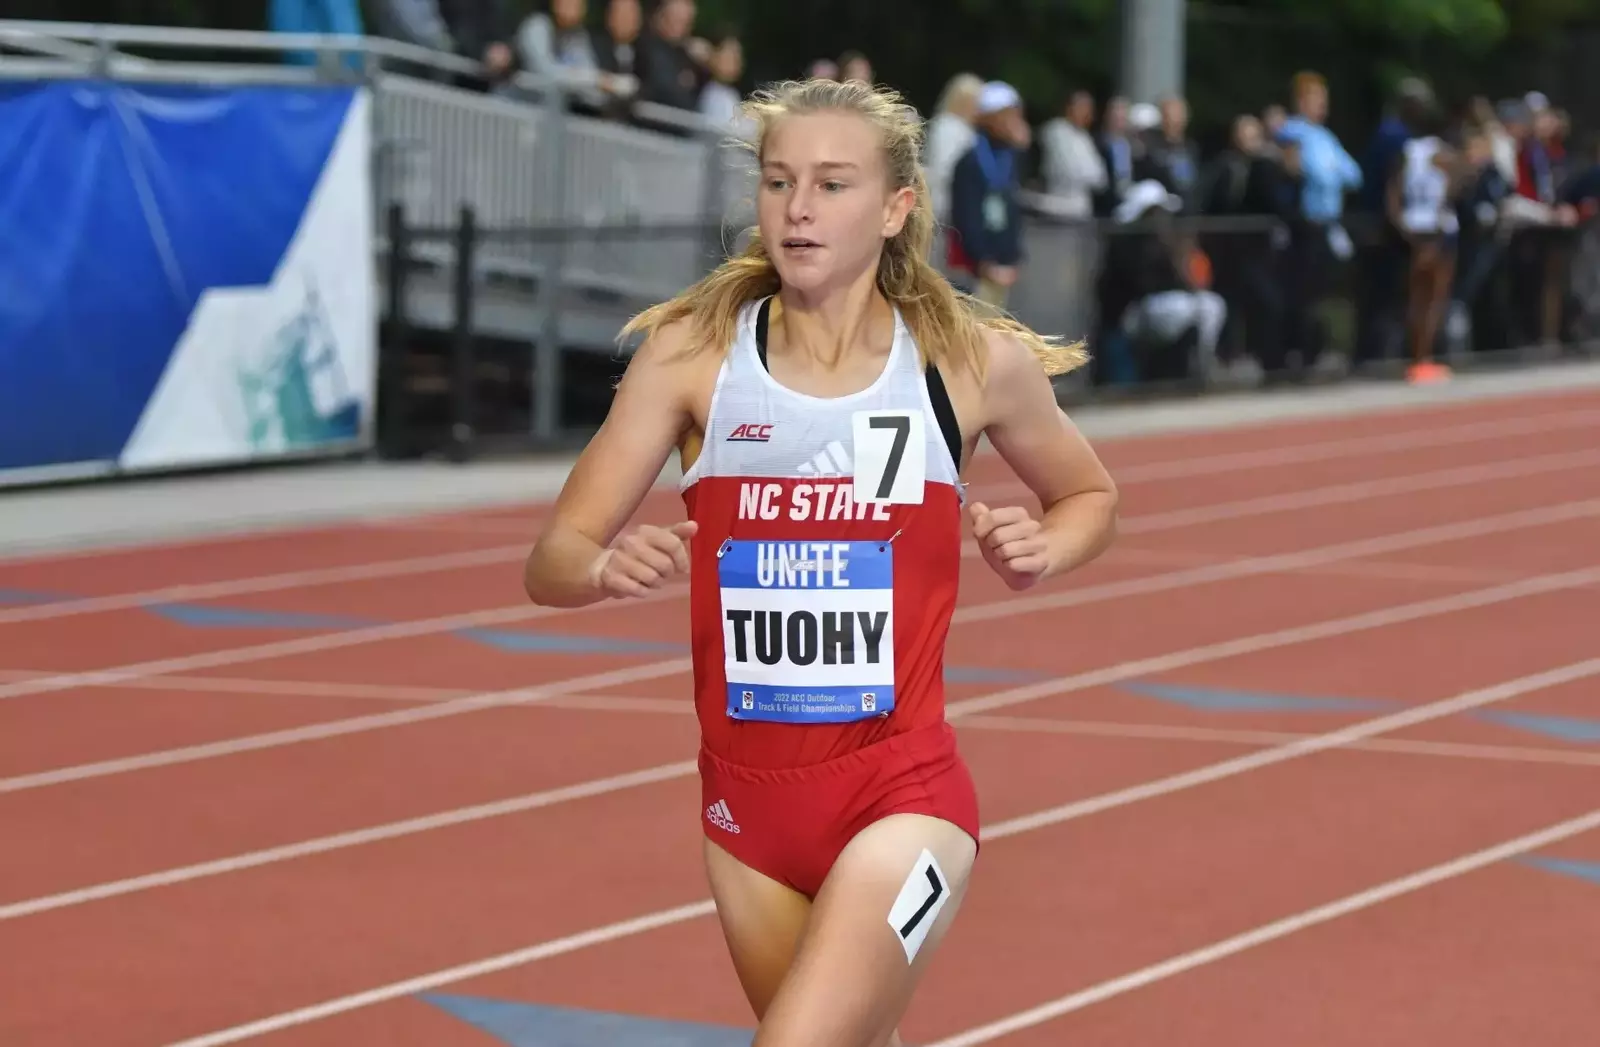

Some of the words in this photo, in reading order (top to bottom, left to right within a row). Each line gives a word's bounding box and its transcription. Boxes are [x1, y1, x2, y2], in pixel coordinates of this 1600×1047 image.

[729, 423, 774, 438] ACC
[868, 415, 910, 499] 7
[738, 482, 783, 521] NC
[757, 543, 850, 587] UNITE
[726, 609, 889, 666] TUOHY
[758, 702, 775, 712] Track
[776, 703, 782, 712] &
[783, 703, 800, 713] Field
[801, 704, 856, 714] Championships
[774, 693, 790, 702] 2022
[791, 693, 805, 702] ACC
[807, 693, 836, 703] Outdoor
[706, 808, 740, 834] adidas
